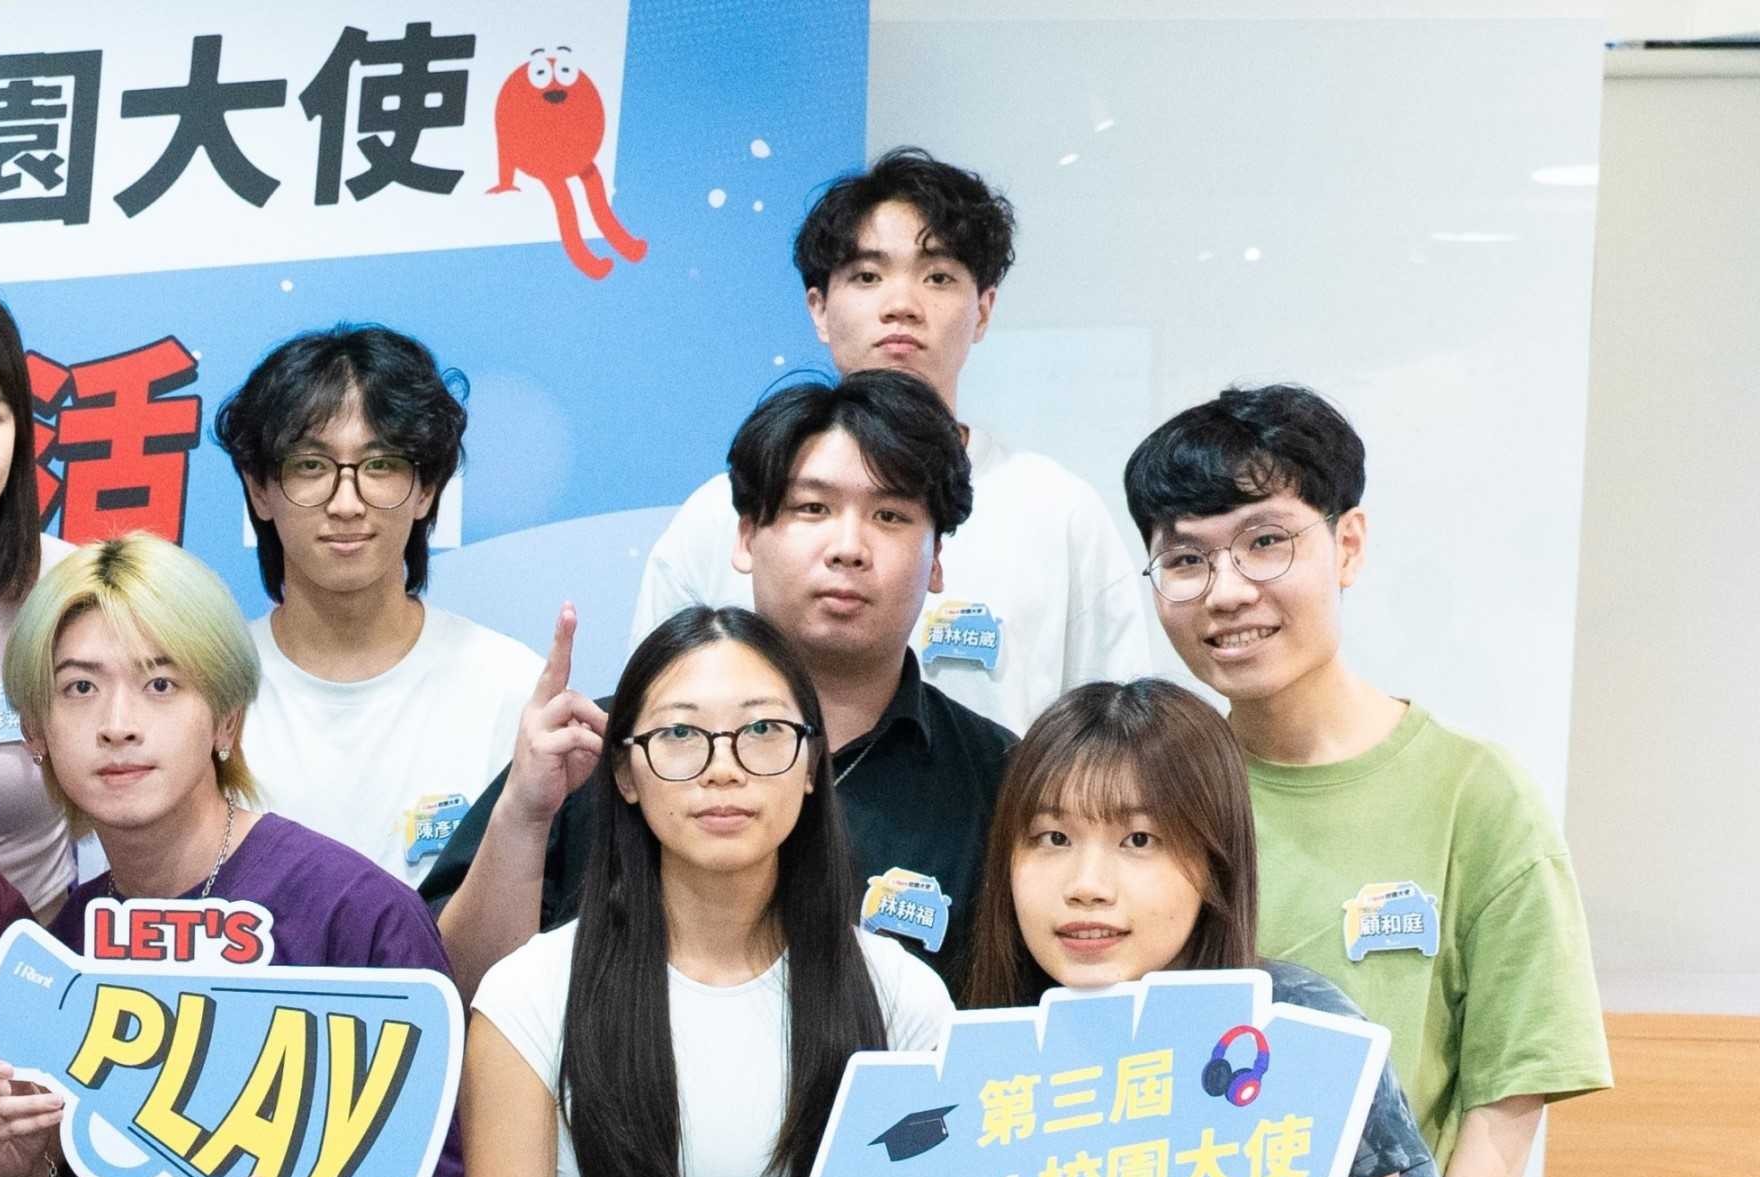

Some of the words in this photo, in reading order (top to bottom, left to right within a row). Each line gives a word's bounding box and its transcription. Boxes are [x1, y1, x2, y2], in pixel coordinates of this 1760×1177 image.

[416, 819, 460, 840] 陳彥
[879, 895, 937, 928] 林耕福
[1359, 912, 1424, 937] 顧和庭
[93, 908, 263, 965] LET'S
[976, 1048, 1175, 1149] 第三屆
